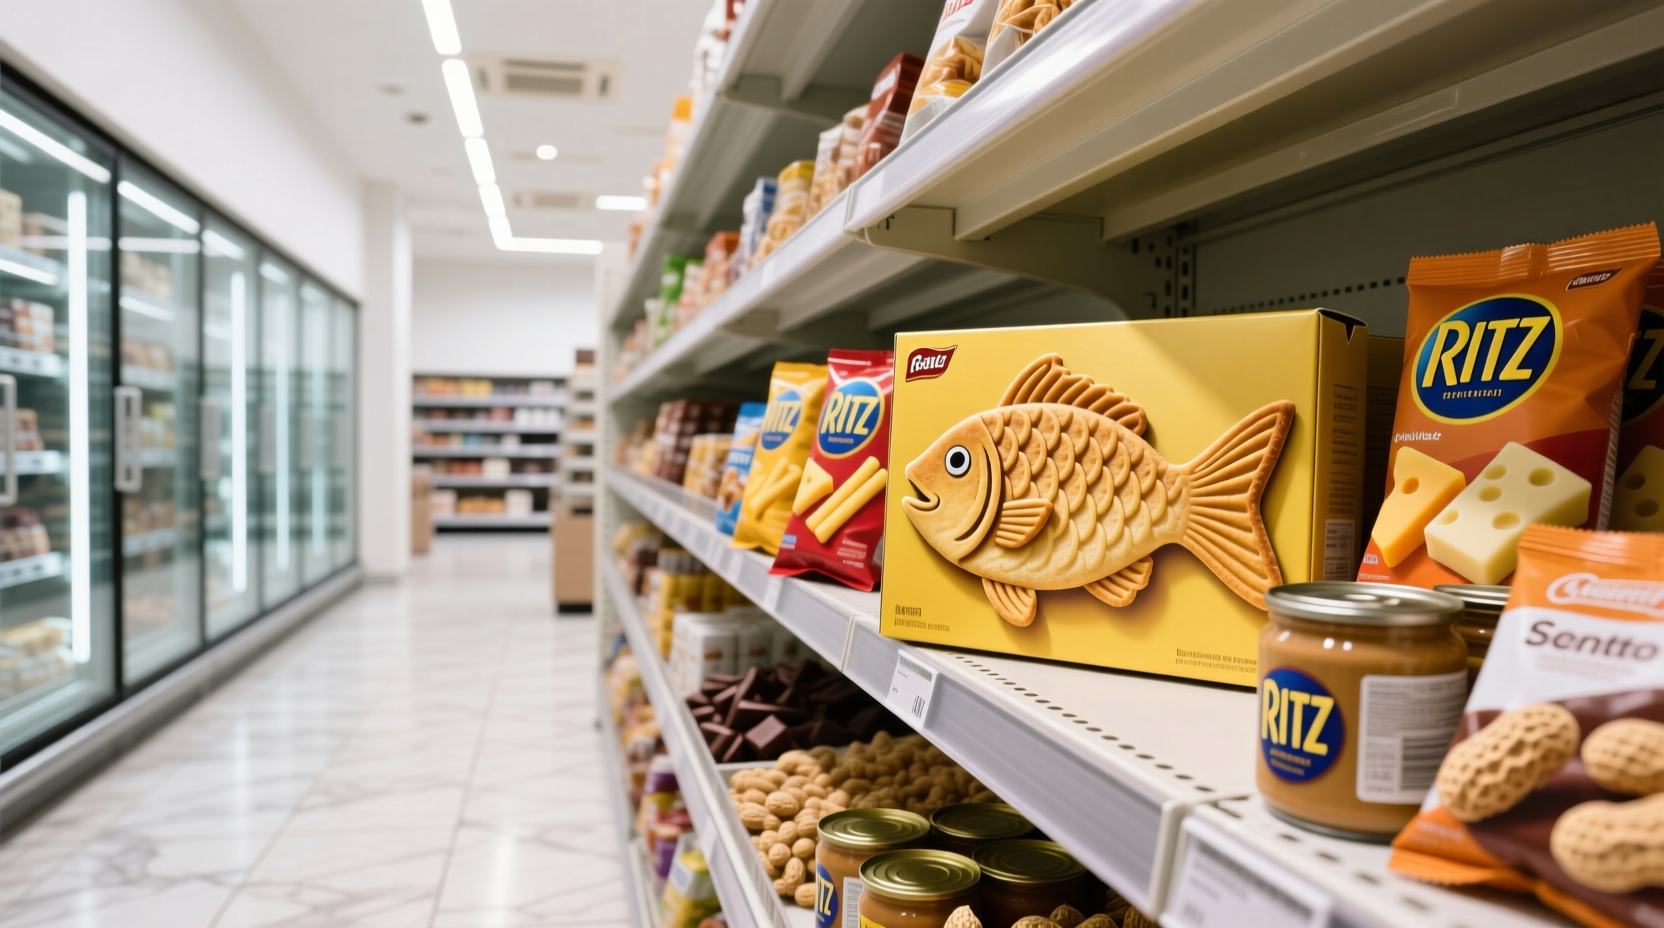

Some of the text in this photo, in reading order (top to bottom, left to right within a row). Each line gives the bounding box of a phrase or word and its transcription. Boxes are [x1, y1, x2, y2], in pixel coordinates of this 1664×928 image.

[1422, 316, 1551, 388] RITZ
[820, 391, 880, 435] RITZ
[1261, 678, 1335, 756] RITZ
